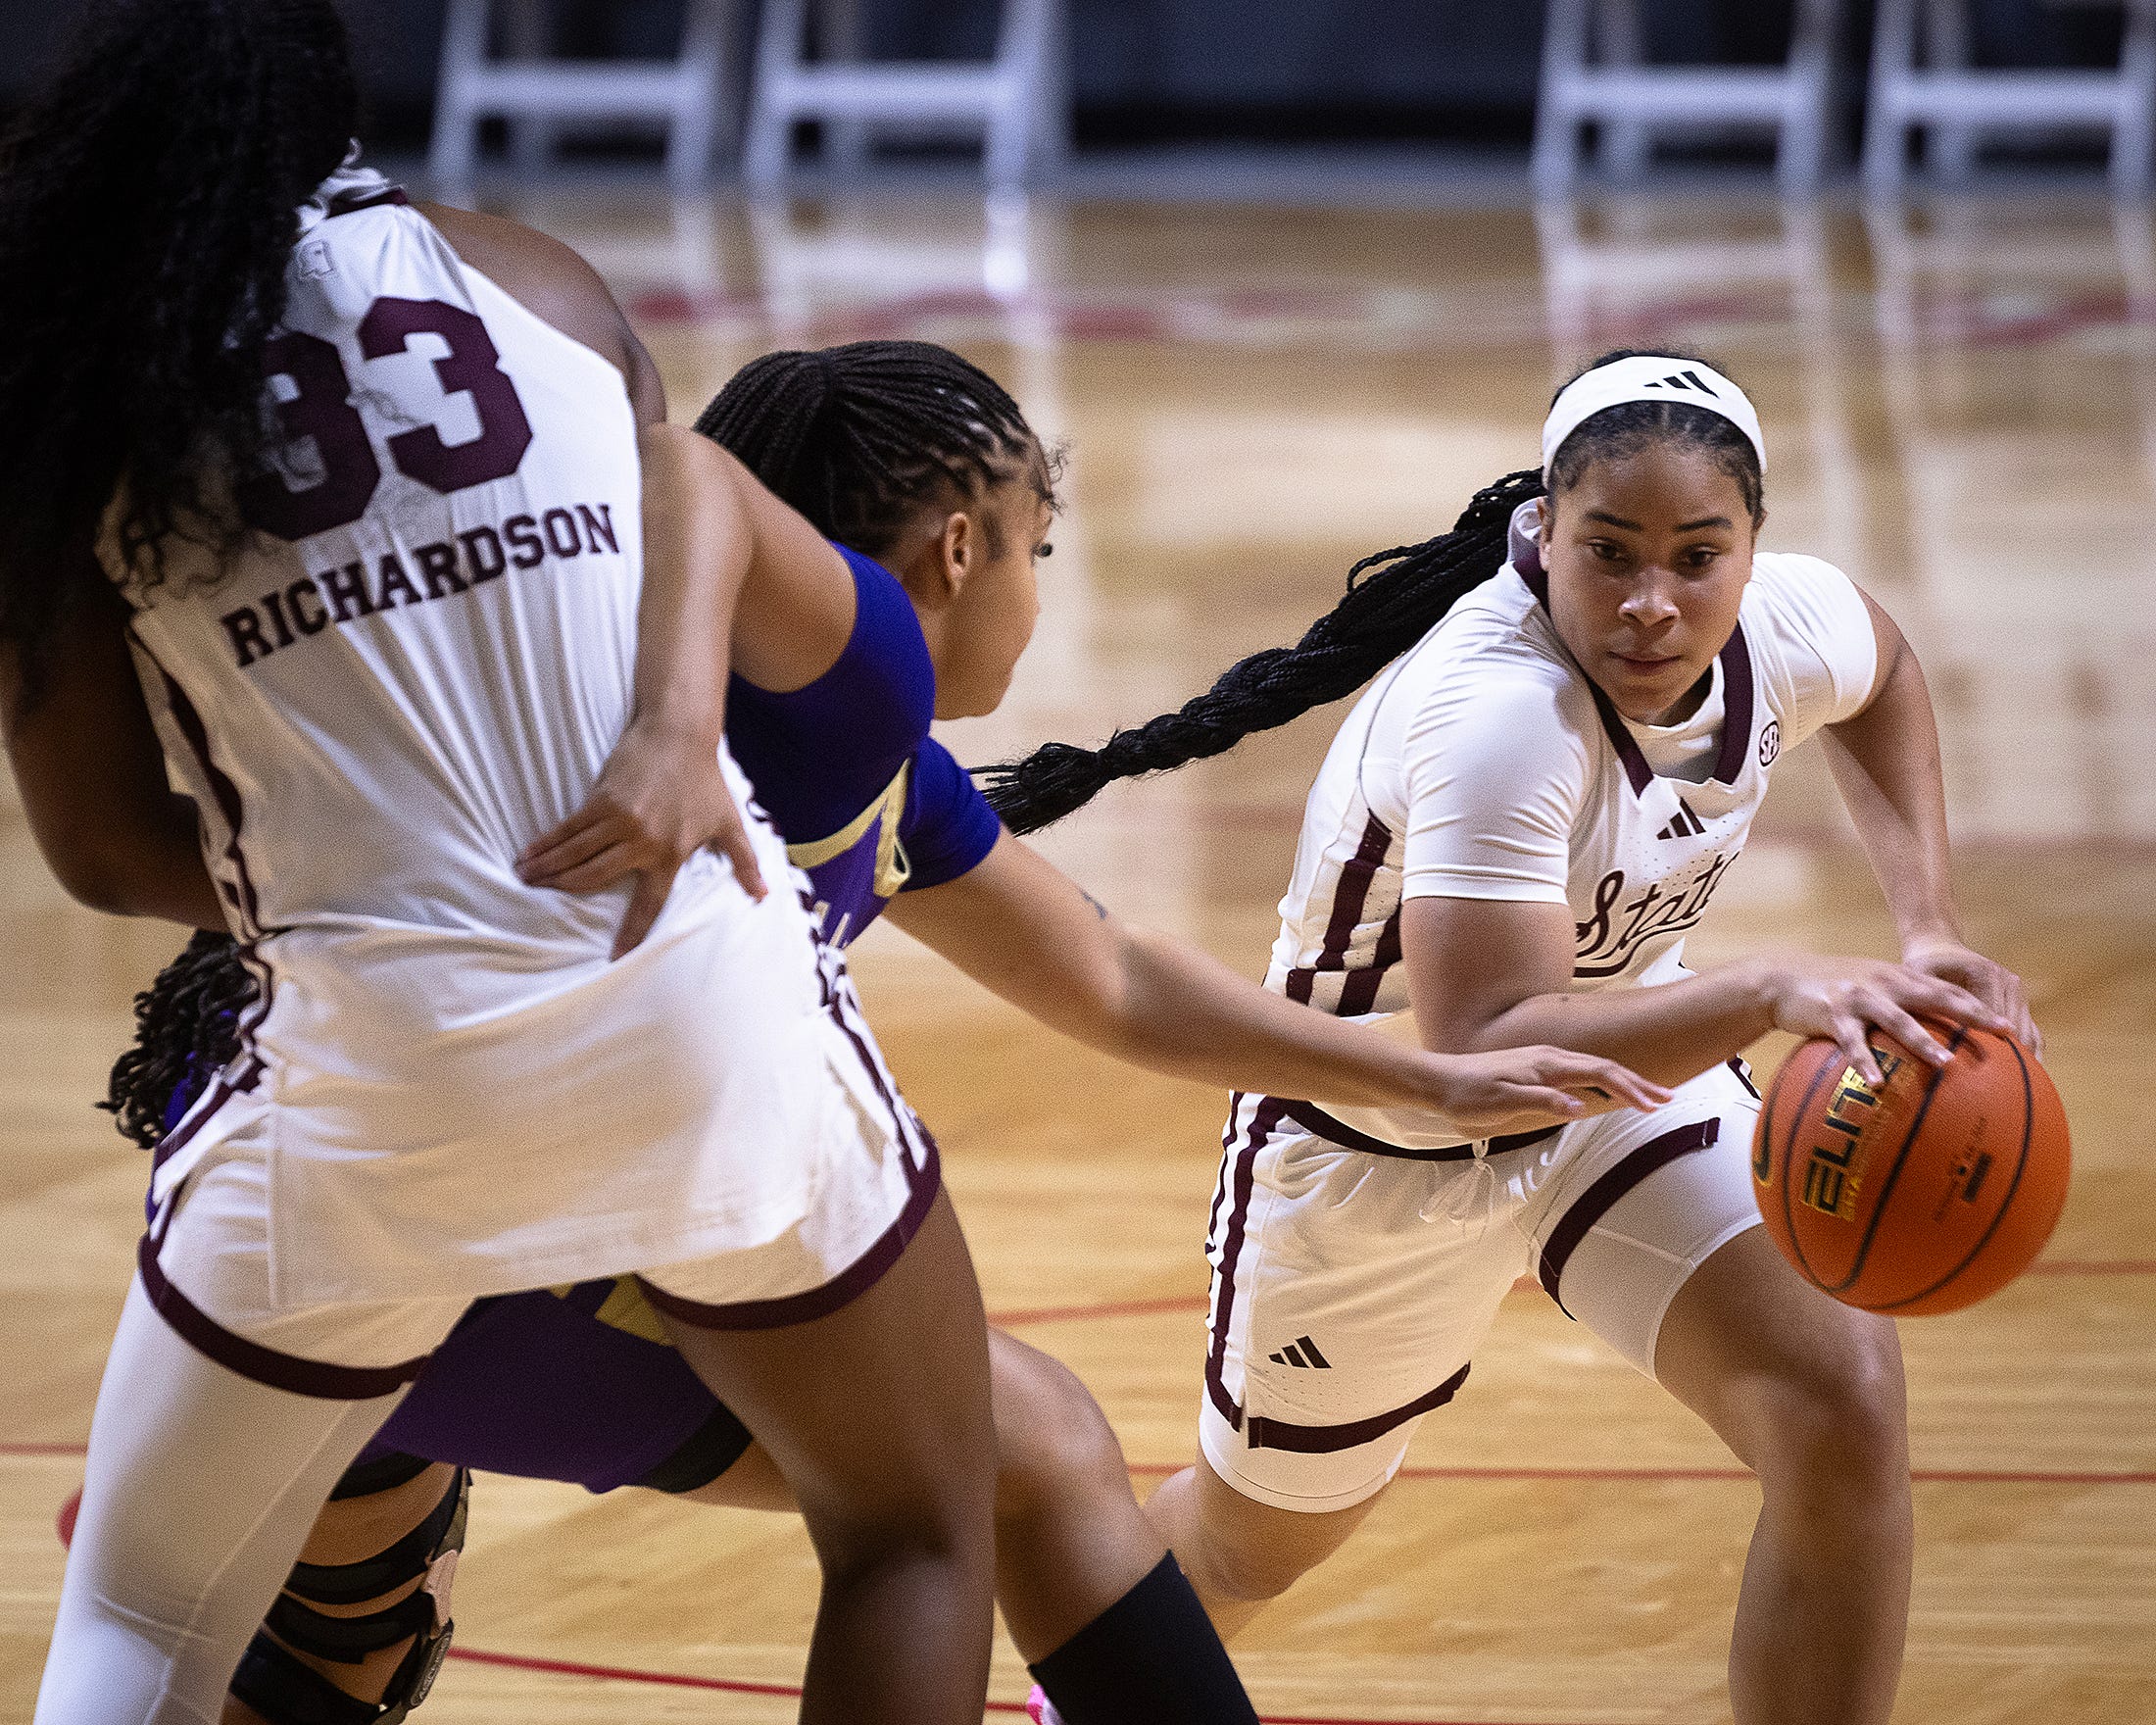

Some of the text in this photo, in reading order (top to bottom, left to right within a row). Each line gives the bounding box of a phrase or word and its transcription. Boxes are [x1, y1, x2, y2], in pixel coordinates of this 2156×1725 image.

[235, 296, 534, 541] 33
[220, 503, 620, 667] RICHARDSON
[1575, 850, 1740, 961] Stat
